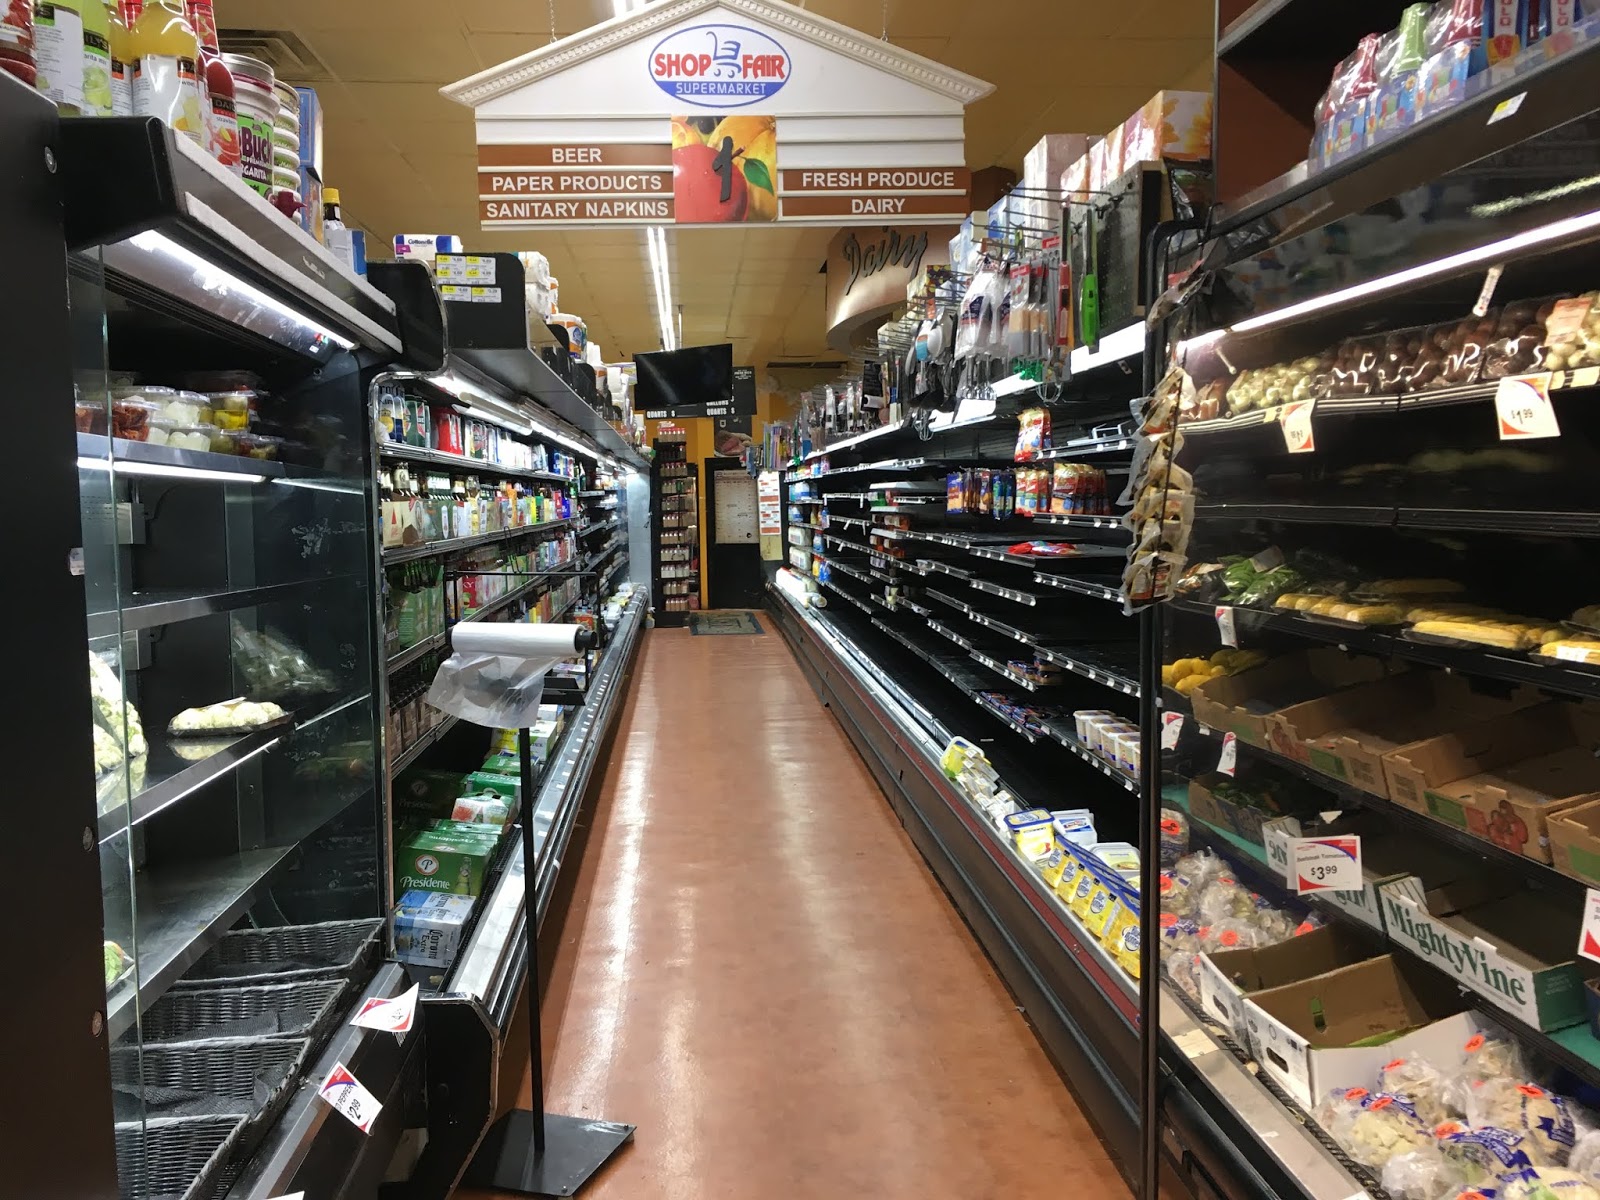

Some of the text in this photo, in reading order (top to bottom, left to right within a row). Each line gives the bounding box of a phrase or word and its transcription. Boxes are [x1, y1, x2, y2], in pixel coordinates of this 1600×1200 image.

[654, 53, 786, 79] SHOP FAIR
[675, 83, 766, 94] SUPERMARKET
[552, 148, 602, 164] BEER
[241, 164, 267, 180] RGARITA
[712, 136, 734, 202] 1
[492, 175, 662, 191] PAPER PRODUCTS
[802, 172, 954, 187] FRESH PRODUCE
[486, 201, 669, 218] SANITARY NAPKINS
[851, 198, 905, 213] DAIRY
[842, 226, 928, 296] Dairy
[646, 410, 667, 418] QUARTS
[706, 408, 727, 416] QUARTS
[400, 876, 450, 890] Presidente
[420, 933, 430, 953] Extra
[428, 929, 444, 959] Corona
[1386, 897, 1527, 1006] MightyVine
